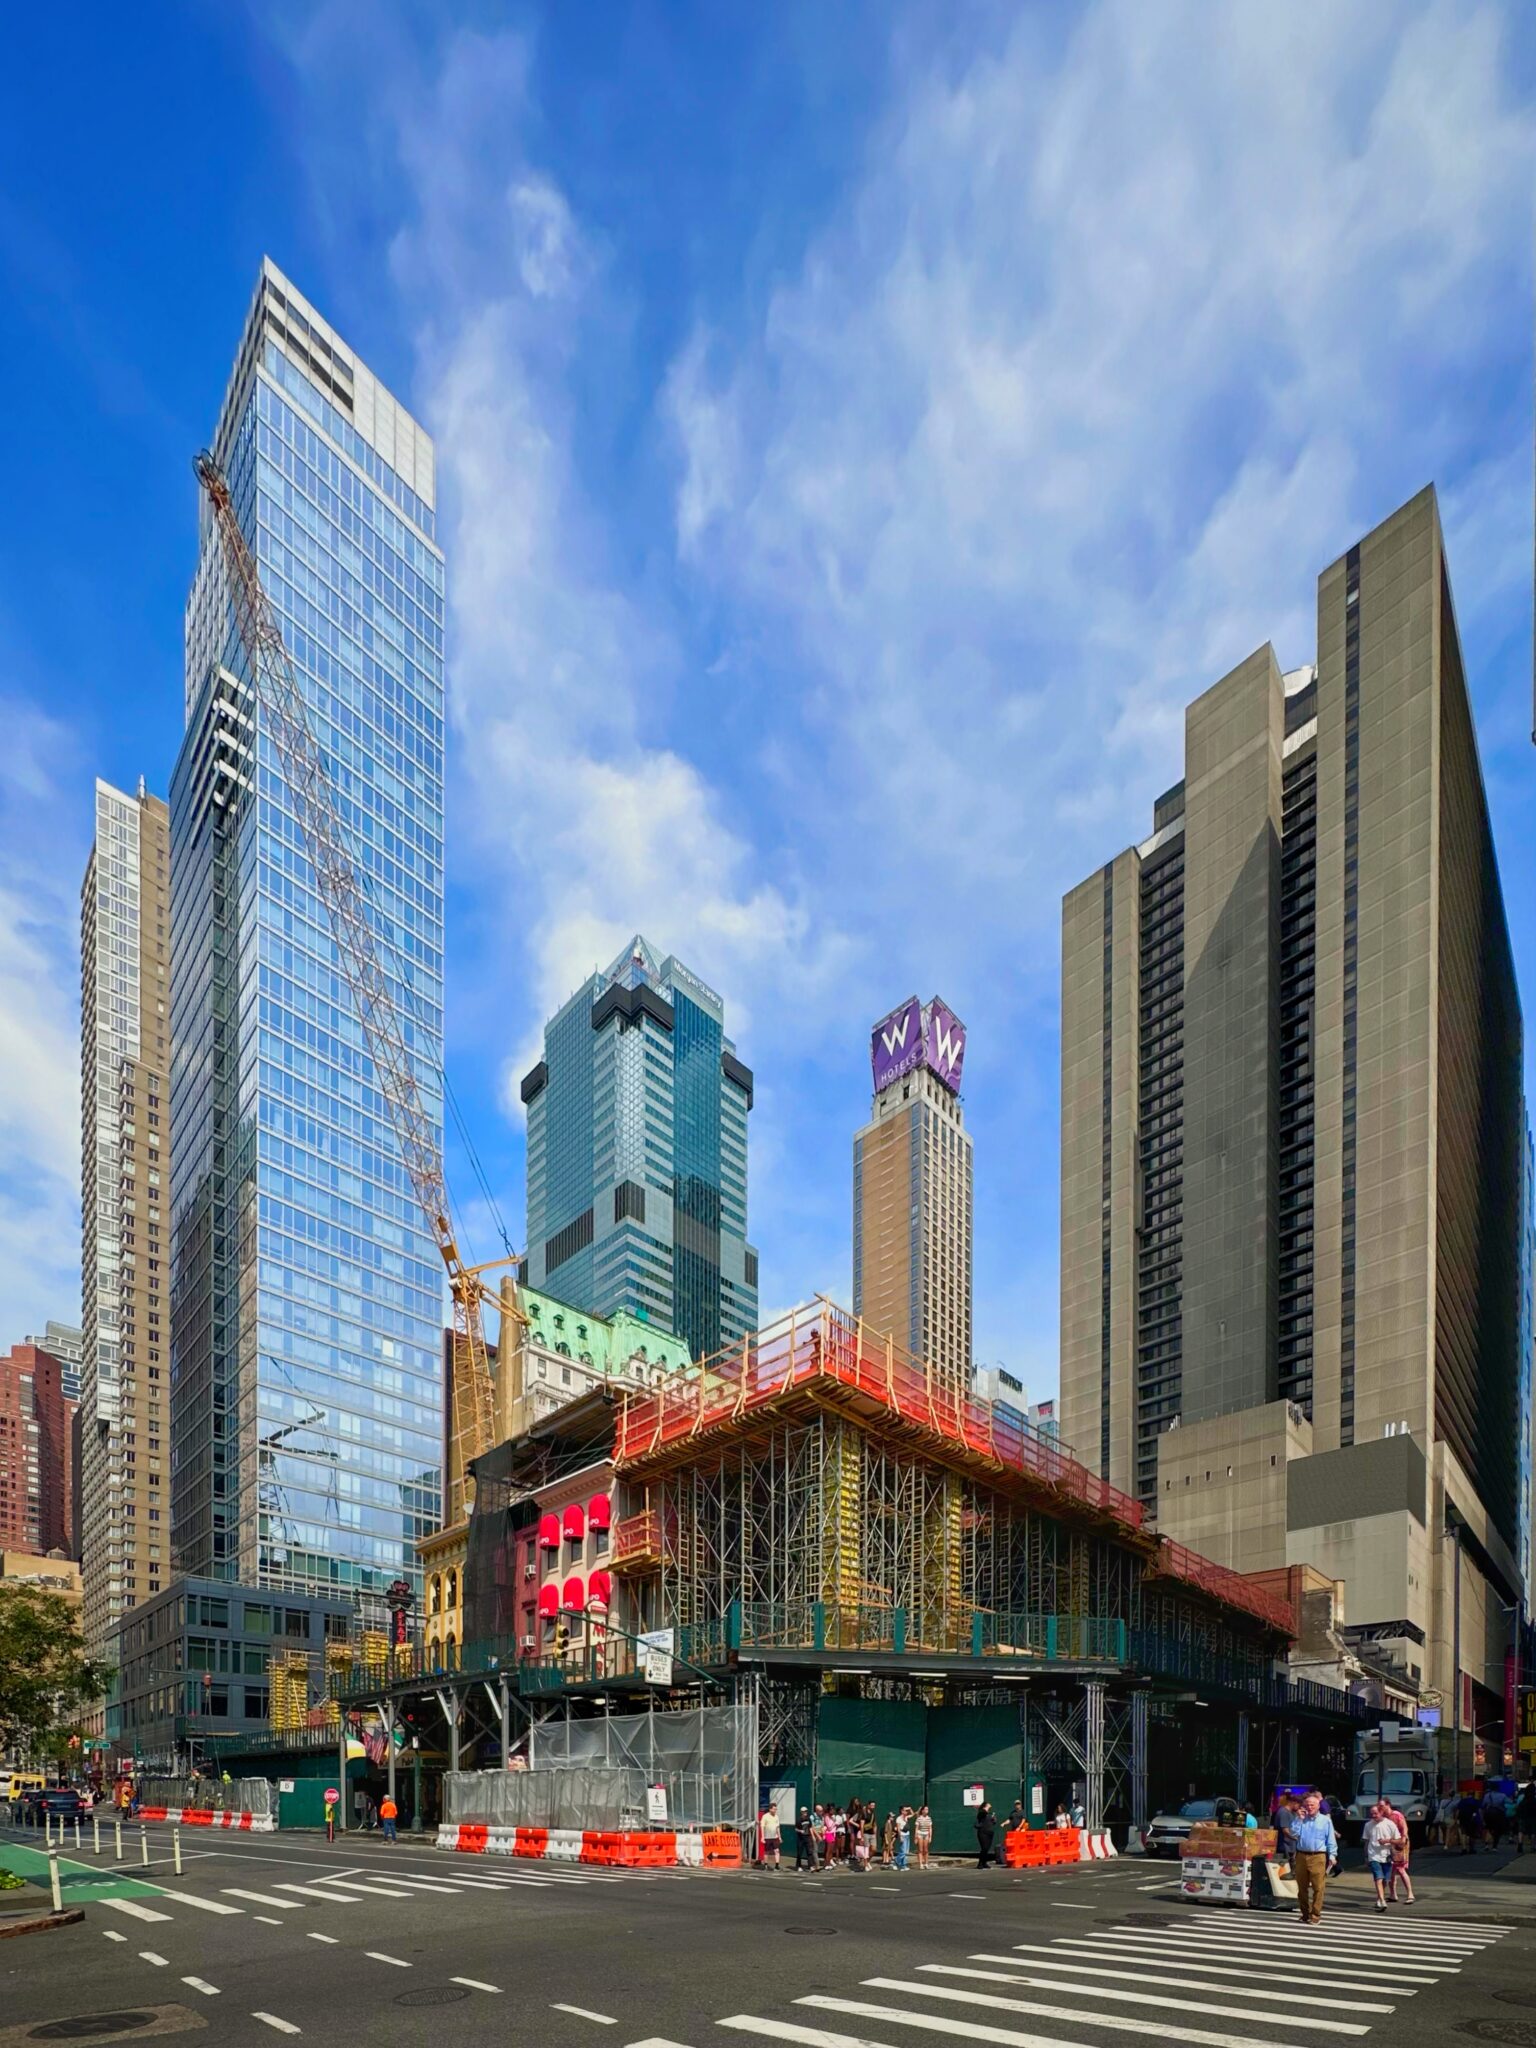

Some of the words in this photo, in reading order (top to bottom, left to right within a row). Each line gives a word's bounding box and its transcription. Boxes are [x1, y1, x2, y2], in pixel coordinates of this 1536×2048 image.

[881, 1014, 910, 1057] W
[935, 1015, 962, 1073] W
[881, 1052, 917, 1083] HOTELS
[704, 1835, 719, 1847] LANE
[720, 1835, 740, 1847] CLOSED
